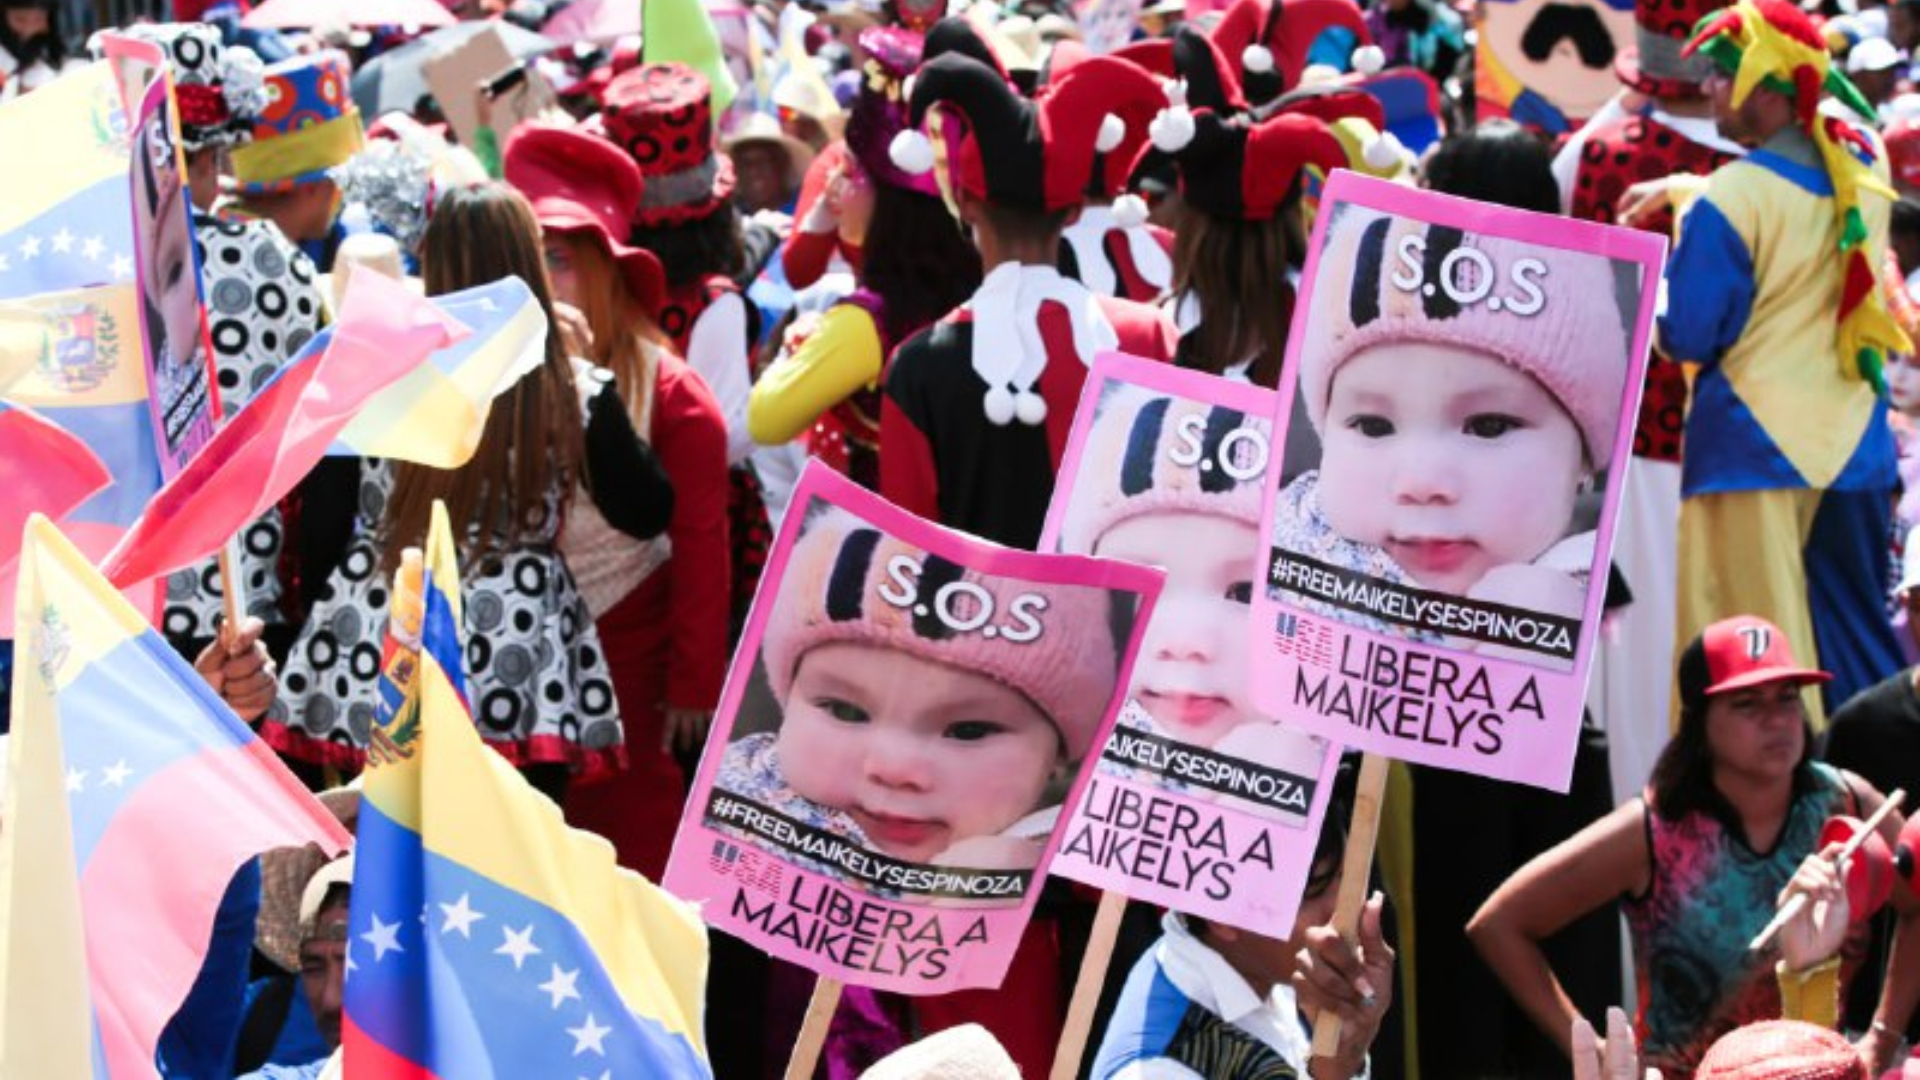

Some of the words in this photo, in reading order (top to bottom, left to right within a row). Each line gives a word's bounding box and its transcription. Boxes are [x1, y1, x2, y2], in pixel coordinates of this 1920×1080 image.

[1391, 234, 1548, 316] S.O.S
[1169, 414, 1269, 481] S.O
[878, 554, 1047, 642] S.O.S
[1272, 557, 1572, 652] #FREEMAIKELYSESPINOZA
[1274, 611, 1334, 671] USA
[1339, 634, 1496, 709] LIBERA
[1507, 674, 1546, 720] A
[1293, 665, 1504, 755] MAIKELYS
[1103, 732, 1307, 809] AIKELYSESPINOZA
[711, 797, 1025, 896] #FREEMAIKELYSESPINOZA
[1059, 823, 1236, 901] AIKELYS
[1084, 780, 1229, 858] LIBERA
[1239, 828, 1275, 871] A
[709, 840, 784, 900] USA
[788, 875, 944, 947] LIBERA
[955, 915, 989, 947] A
[730, 887, 951, 980] MAIKELYS
